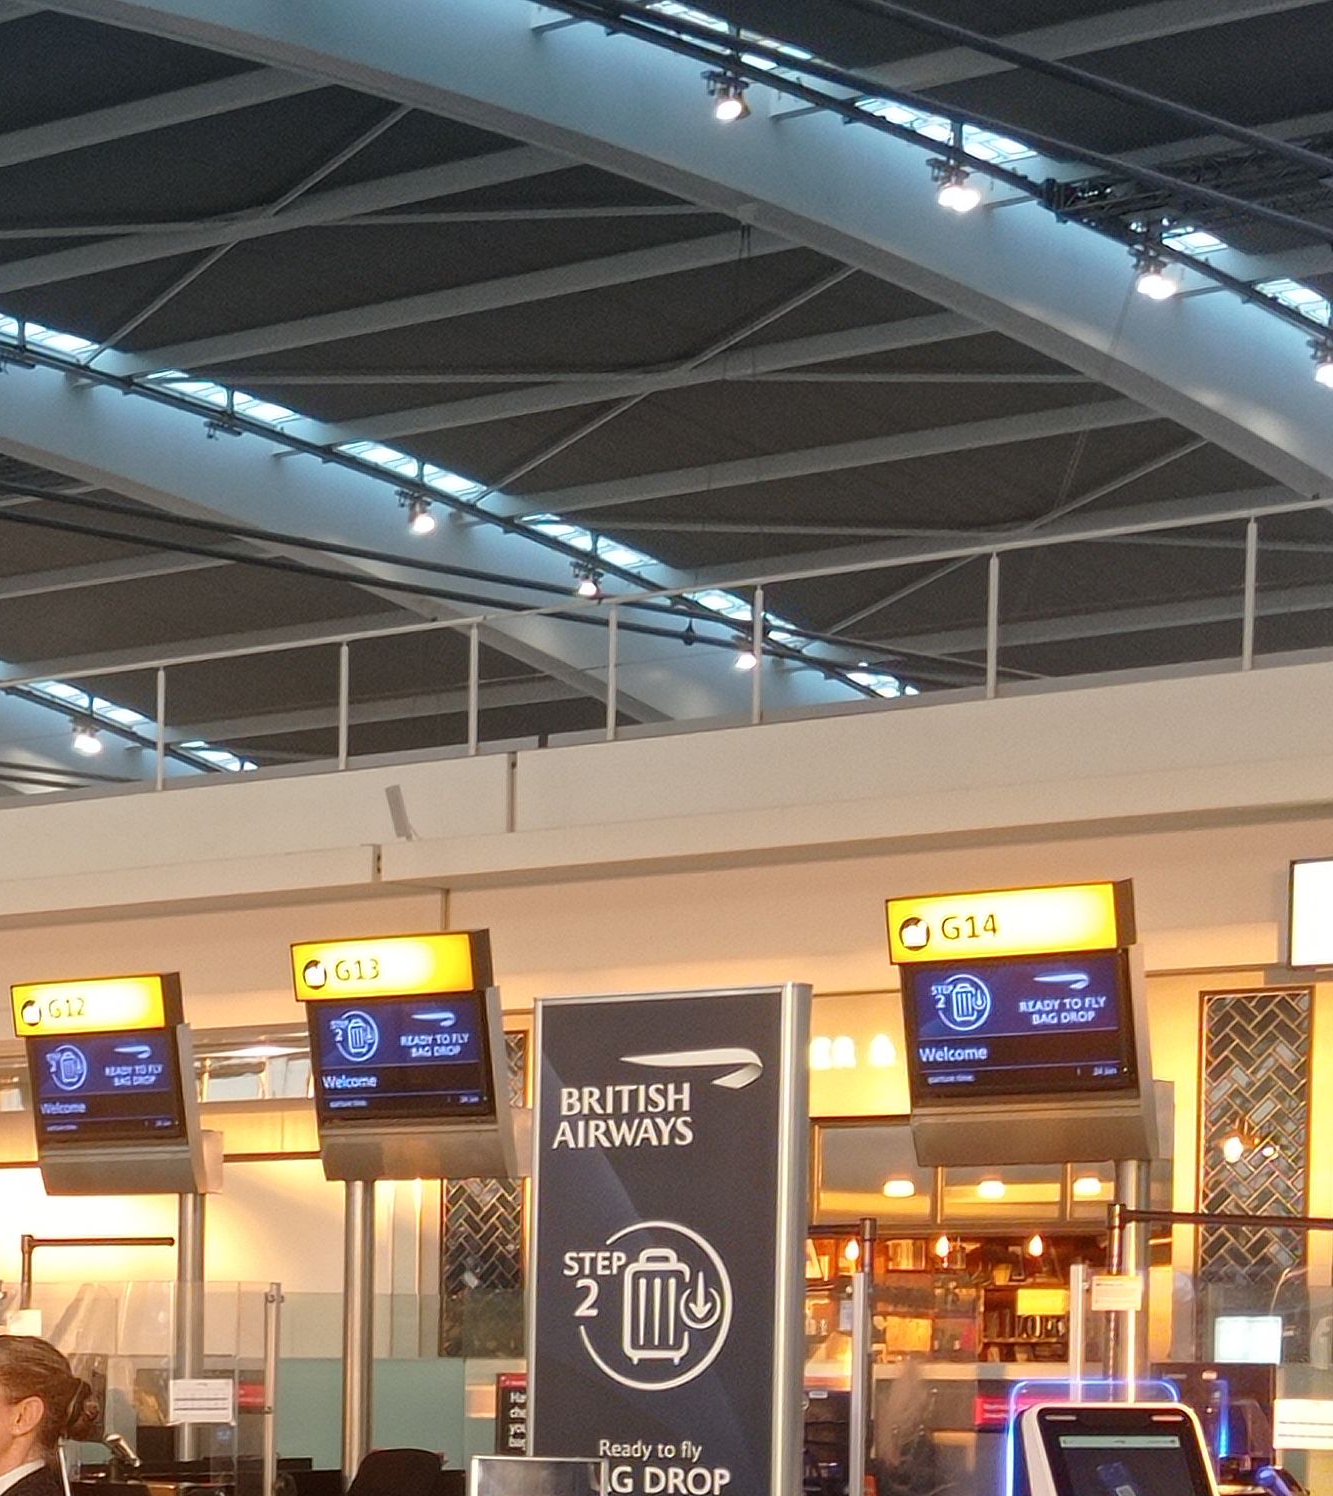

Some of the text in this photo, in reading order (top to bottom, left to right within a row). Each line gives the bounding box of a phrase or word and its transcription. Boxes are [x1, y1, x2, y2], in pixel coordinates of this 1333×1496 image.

[941, 914, 997, 940] G14
[335, 959, 380, 981] G13
[48, 998, 85, 1018] G12
[935, 995, 946, 1009] 2
[1019, 996, 1107, 1013] READY TO FLY
[1032, 1010, 1096, 1024] BAG DROP
[400, 1033, 469, 1046] READY TO FLY
[919, 1046, 989, 1062] Welcome
[322, 1075, 378, 1089] Welcome
[40, 1102, 87, 1114] Welcome
[559, 1081, 691, 1116] BRITISH
[552, 1115, 694, 1149] AIRWAYS
[563, 1251, 626, 1276] STEP
[573, 1278, 600, 1317] 2
[599, 1439, 703, 1462] Ready to fly
[644, 1465, 731, 1496] DROP
